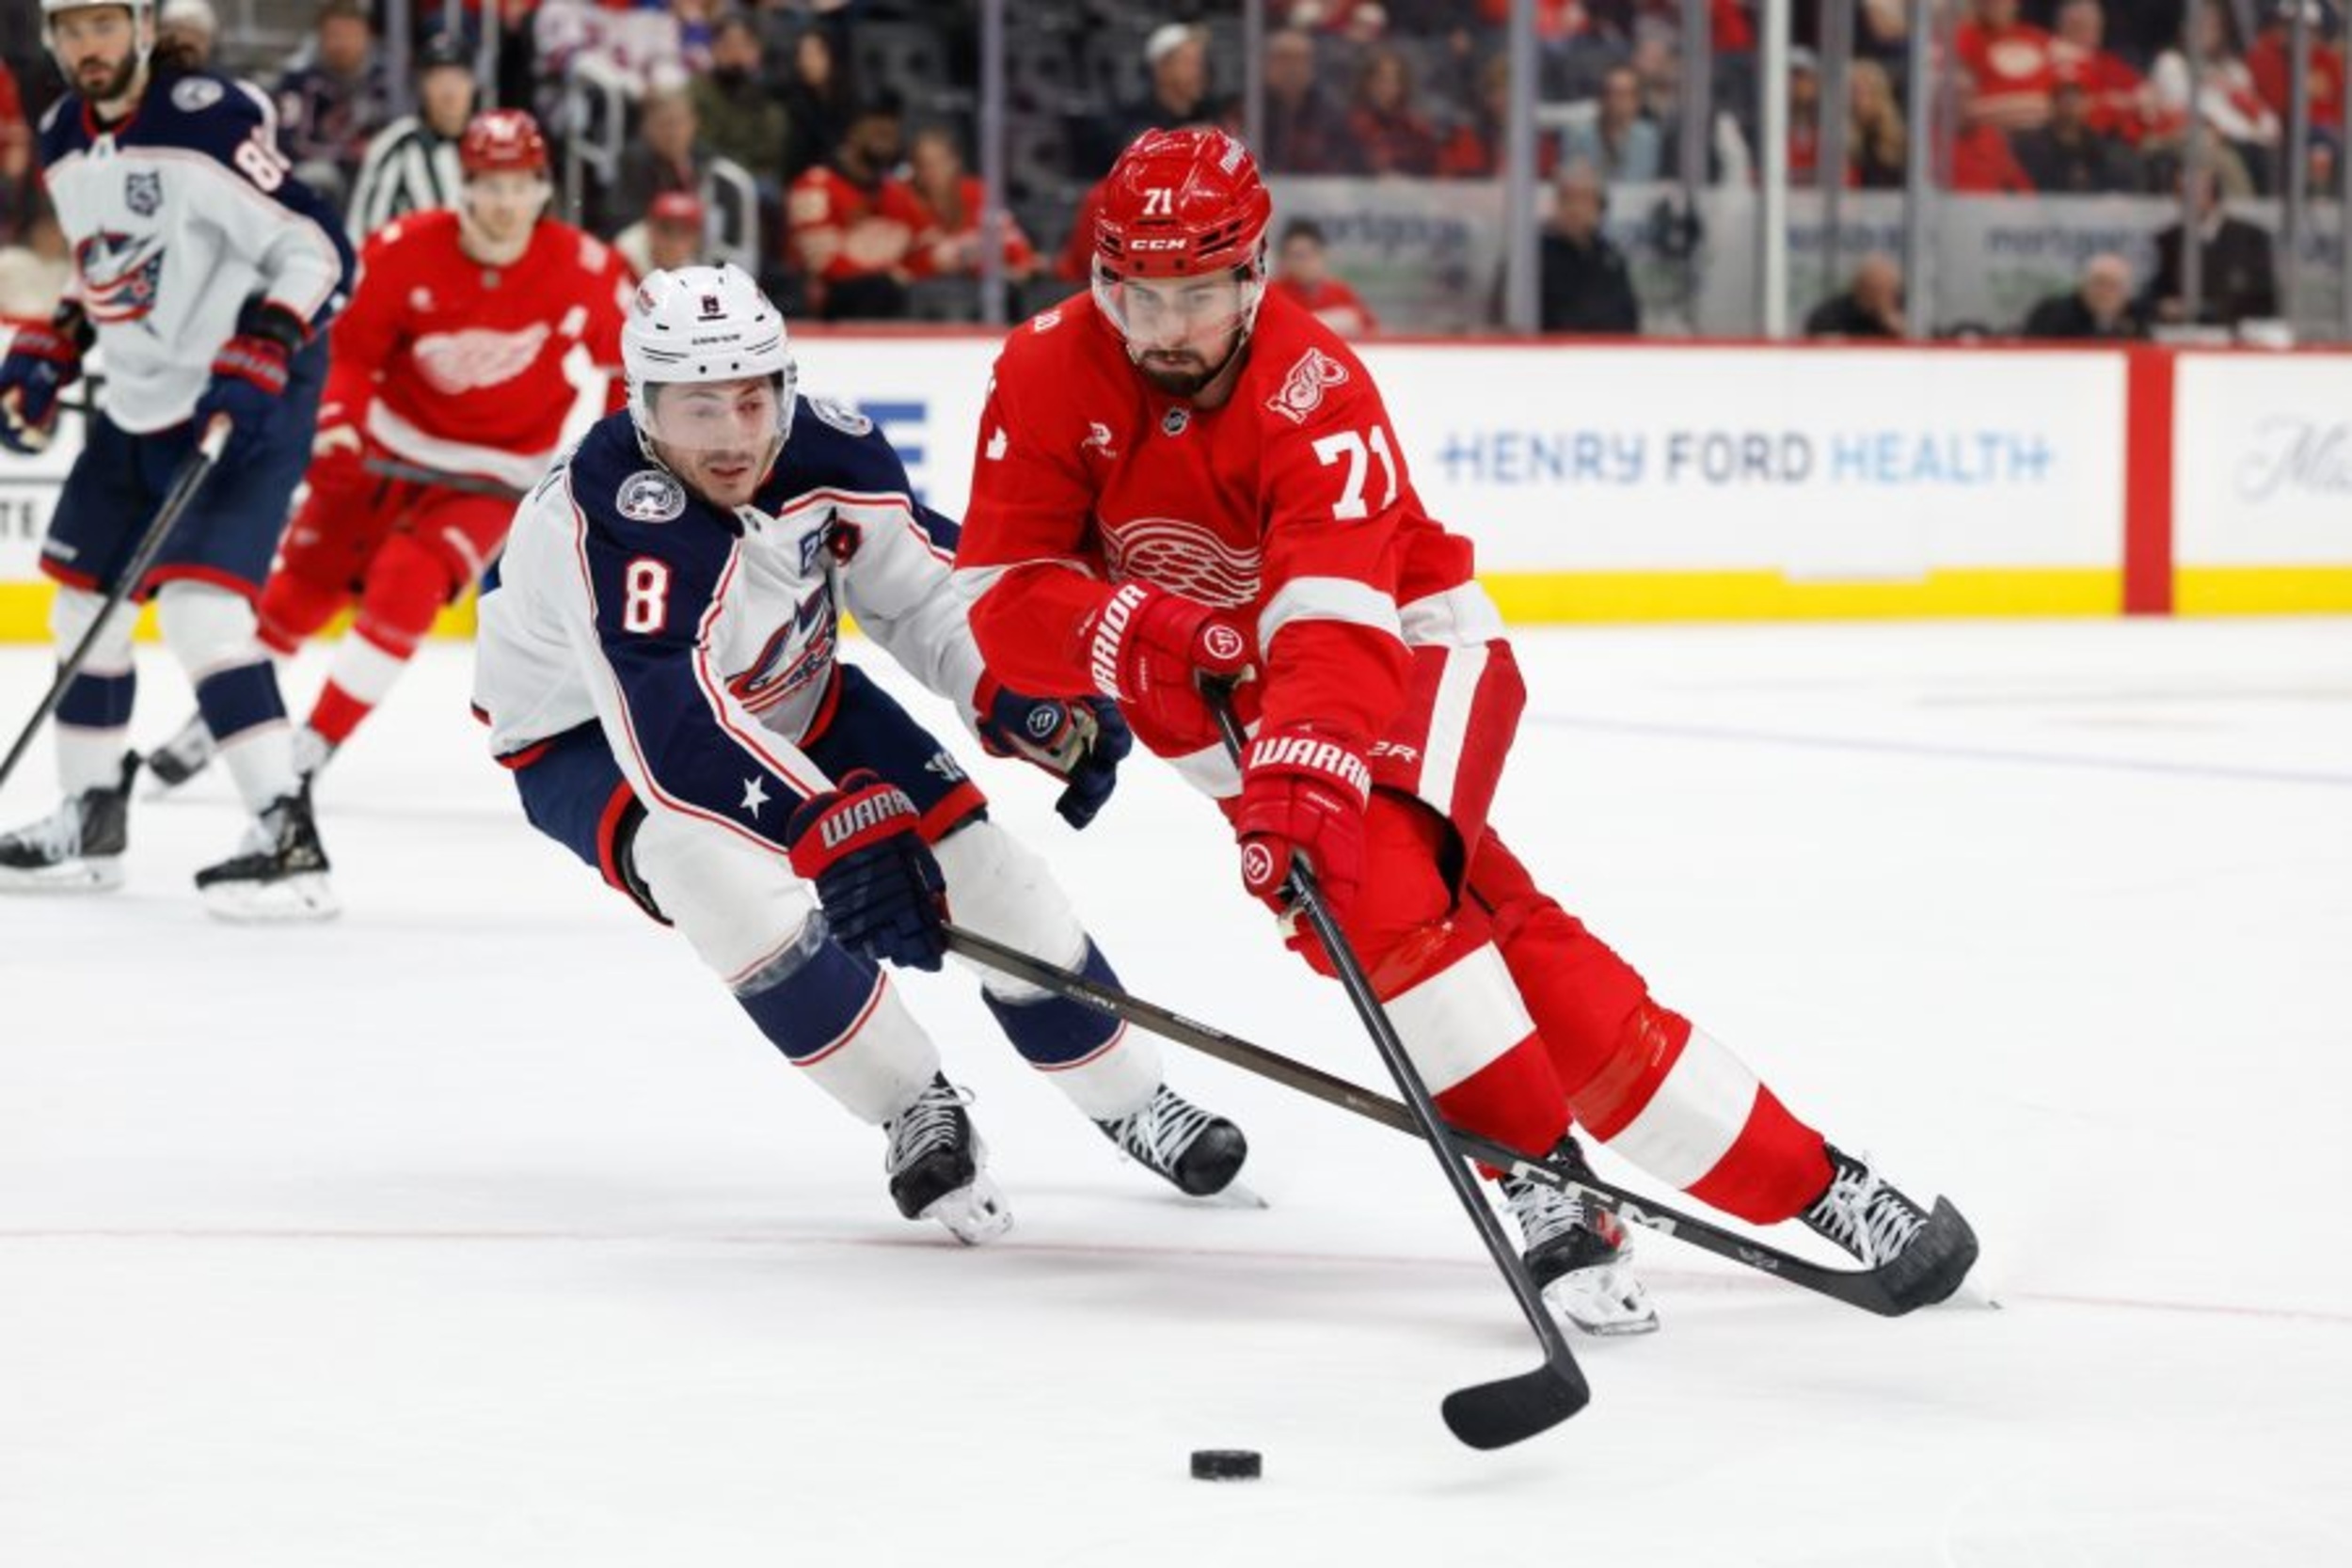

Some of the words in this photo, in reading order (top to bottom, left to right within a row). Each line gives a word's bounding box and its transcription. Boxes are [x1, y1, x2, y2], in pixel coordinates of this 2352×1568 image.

[1142, 187, 1172, 216] 71
[1130, 238, 1187, 251] CCM
[1311, 425, 1397, 521] 71
[1436, 432, 1645, 483] HENRY
[1667, 432, 1812, 483] FORD
[1830, 432, 2051, 483] HEALTH
[623, 554, 672, 635] 8
